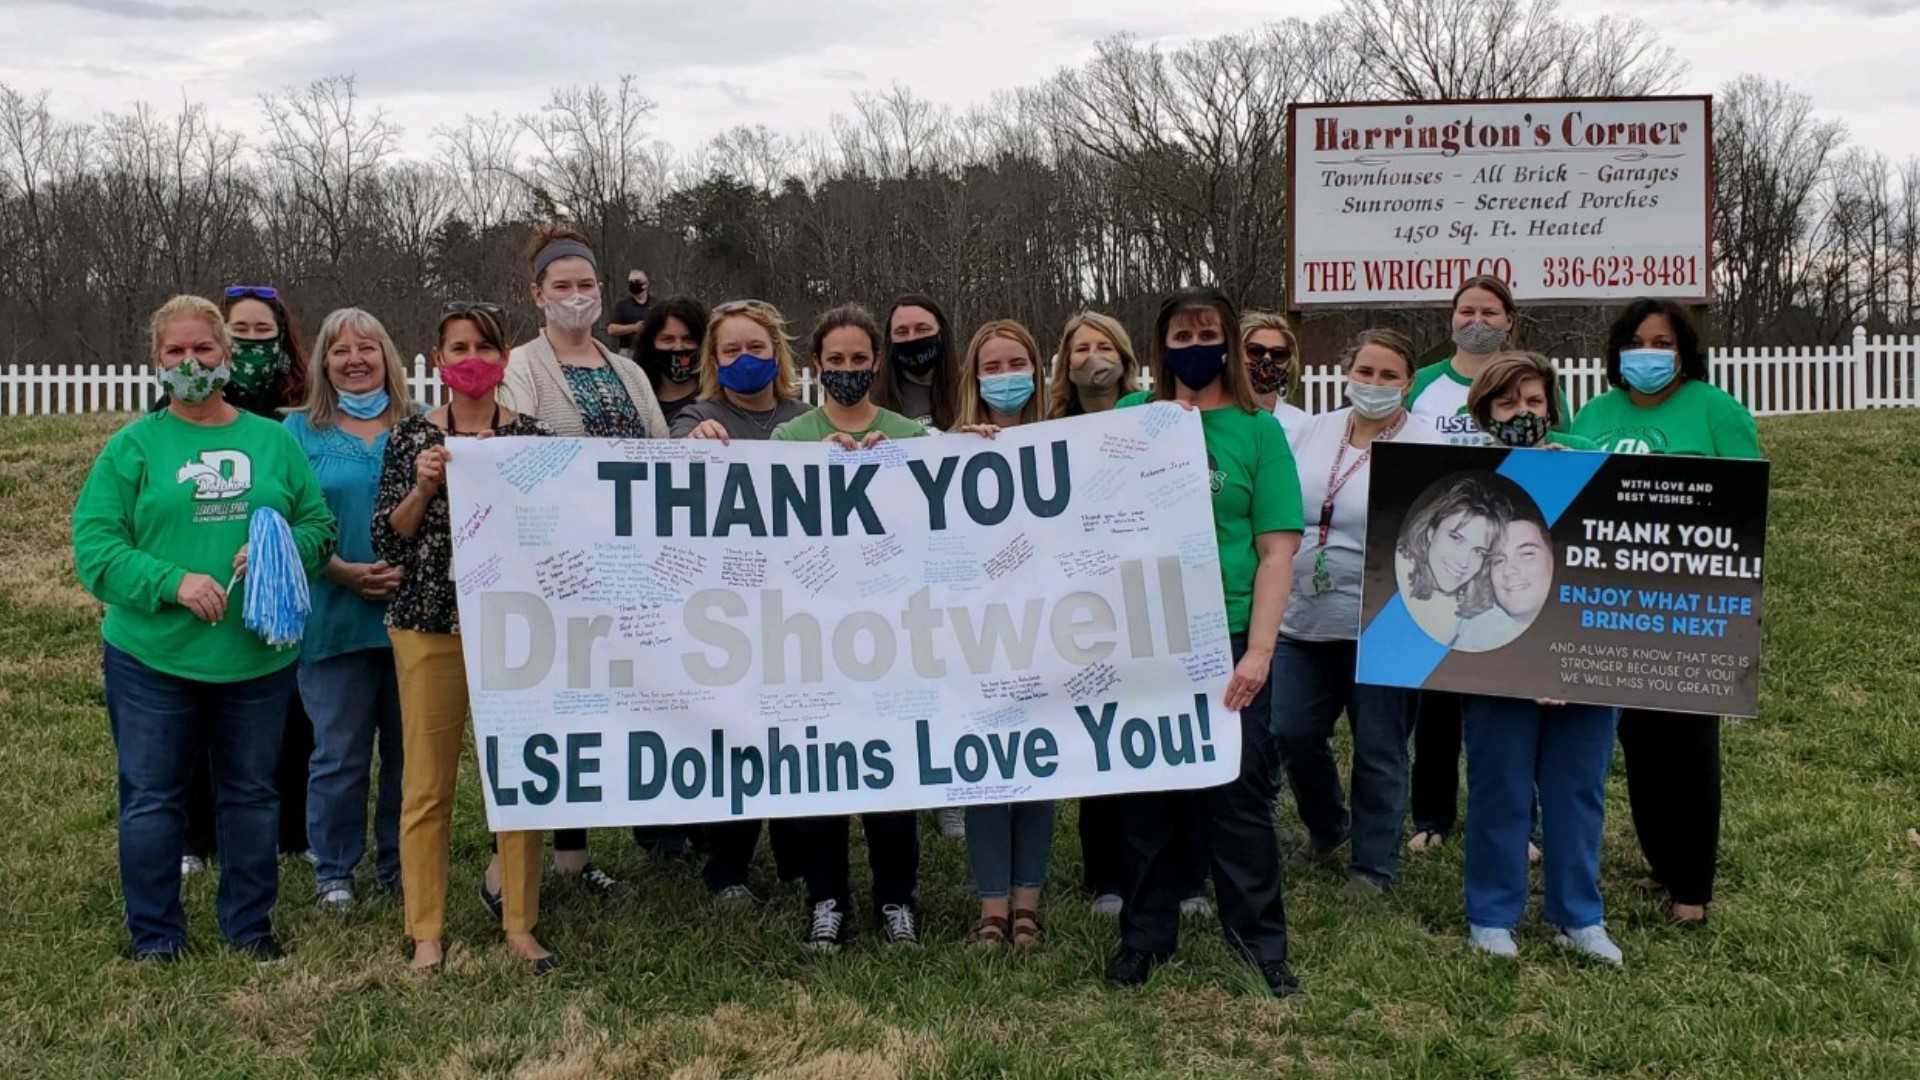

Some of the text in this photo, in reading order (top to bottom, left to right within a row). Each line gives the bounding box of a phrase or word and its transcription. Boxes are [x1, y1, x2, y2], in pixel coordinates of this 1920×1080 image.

[1314, 111, 1688, 157] Harrington's Corner
[1320, 169, 1443, 188] Townhouses
[1471, 165, 1504, 185] All
[1514, 164, 1568, 183] Brick
[1596, 164, 1679, 189] Garages
[1341, 196, 1444, 214] Sunrooms
[1474, 191, 1568, 211] Screened
[1579, 190, 1659, 209] Porches
[1393, 217, 1607, 245] 1450 Sq. Ft. Heated
[1303, 255, 1698, 292] THE WRIGHT CO. 336-623-8481
[1435, 415, 1479, 434] LSE
[598, 461, 885, 537] THANK
[907, 440, 1072, 531] YOU
[1616, 492, 1694, 505] BEST WISHES
[1620, 479, 1713, 493] WITH LOVE AND
[1583, 519, 1740, 552] THANK YOU,
[1565, 546, 1762, 579] DR. SHOTWELL!
[1559, 584, 1752, 616] ENJOY WHAT LIFE
[480, 590, 634, 691] Dr.
[681, 554, 1192, 690] Shotwell
[1581, 610, 1728, 637] BRINGS NEXT
[1549, 641, 1750, 667] AND ALWAYS KNOW THAT RCS IS
[1560, 657, 1736, 681] STRONGER BECAUSE OF YOU!
[1560, 671, 1734, 696] WE WILL MISS YOU GREATLY!
[486, 731, 602, 806] LSE
[628, 725, 894, 815] Dolphins
[916, 719, 1059, 786] Love
[1074, 693, 1216, 772] You!
